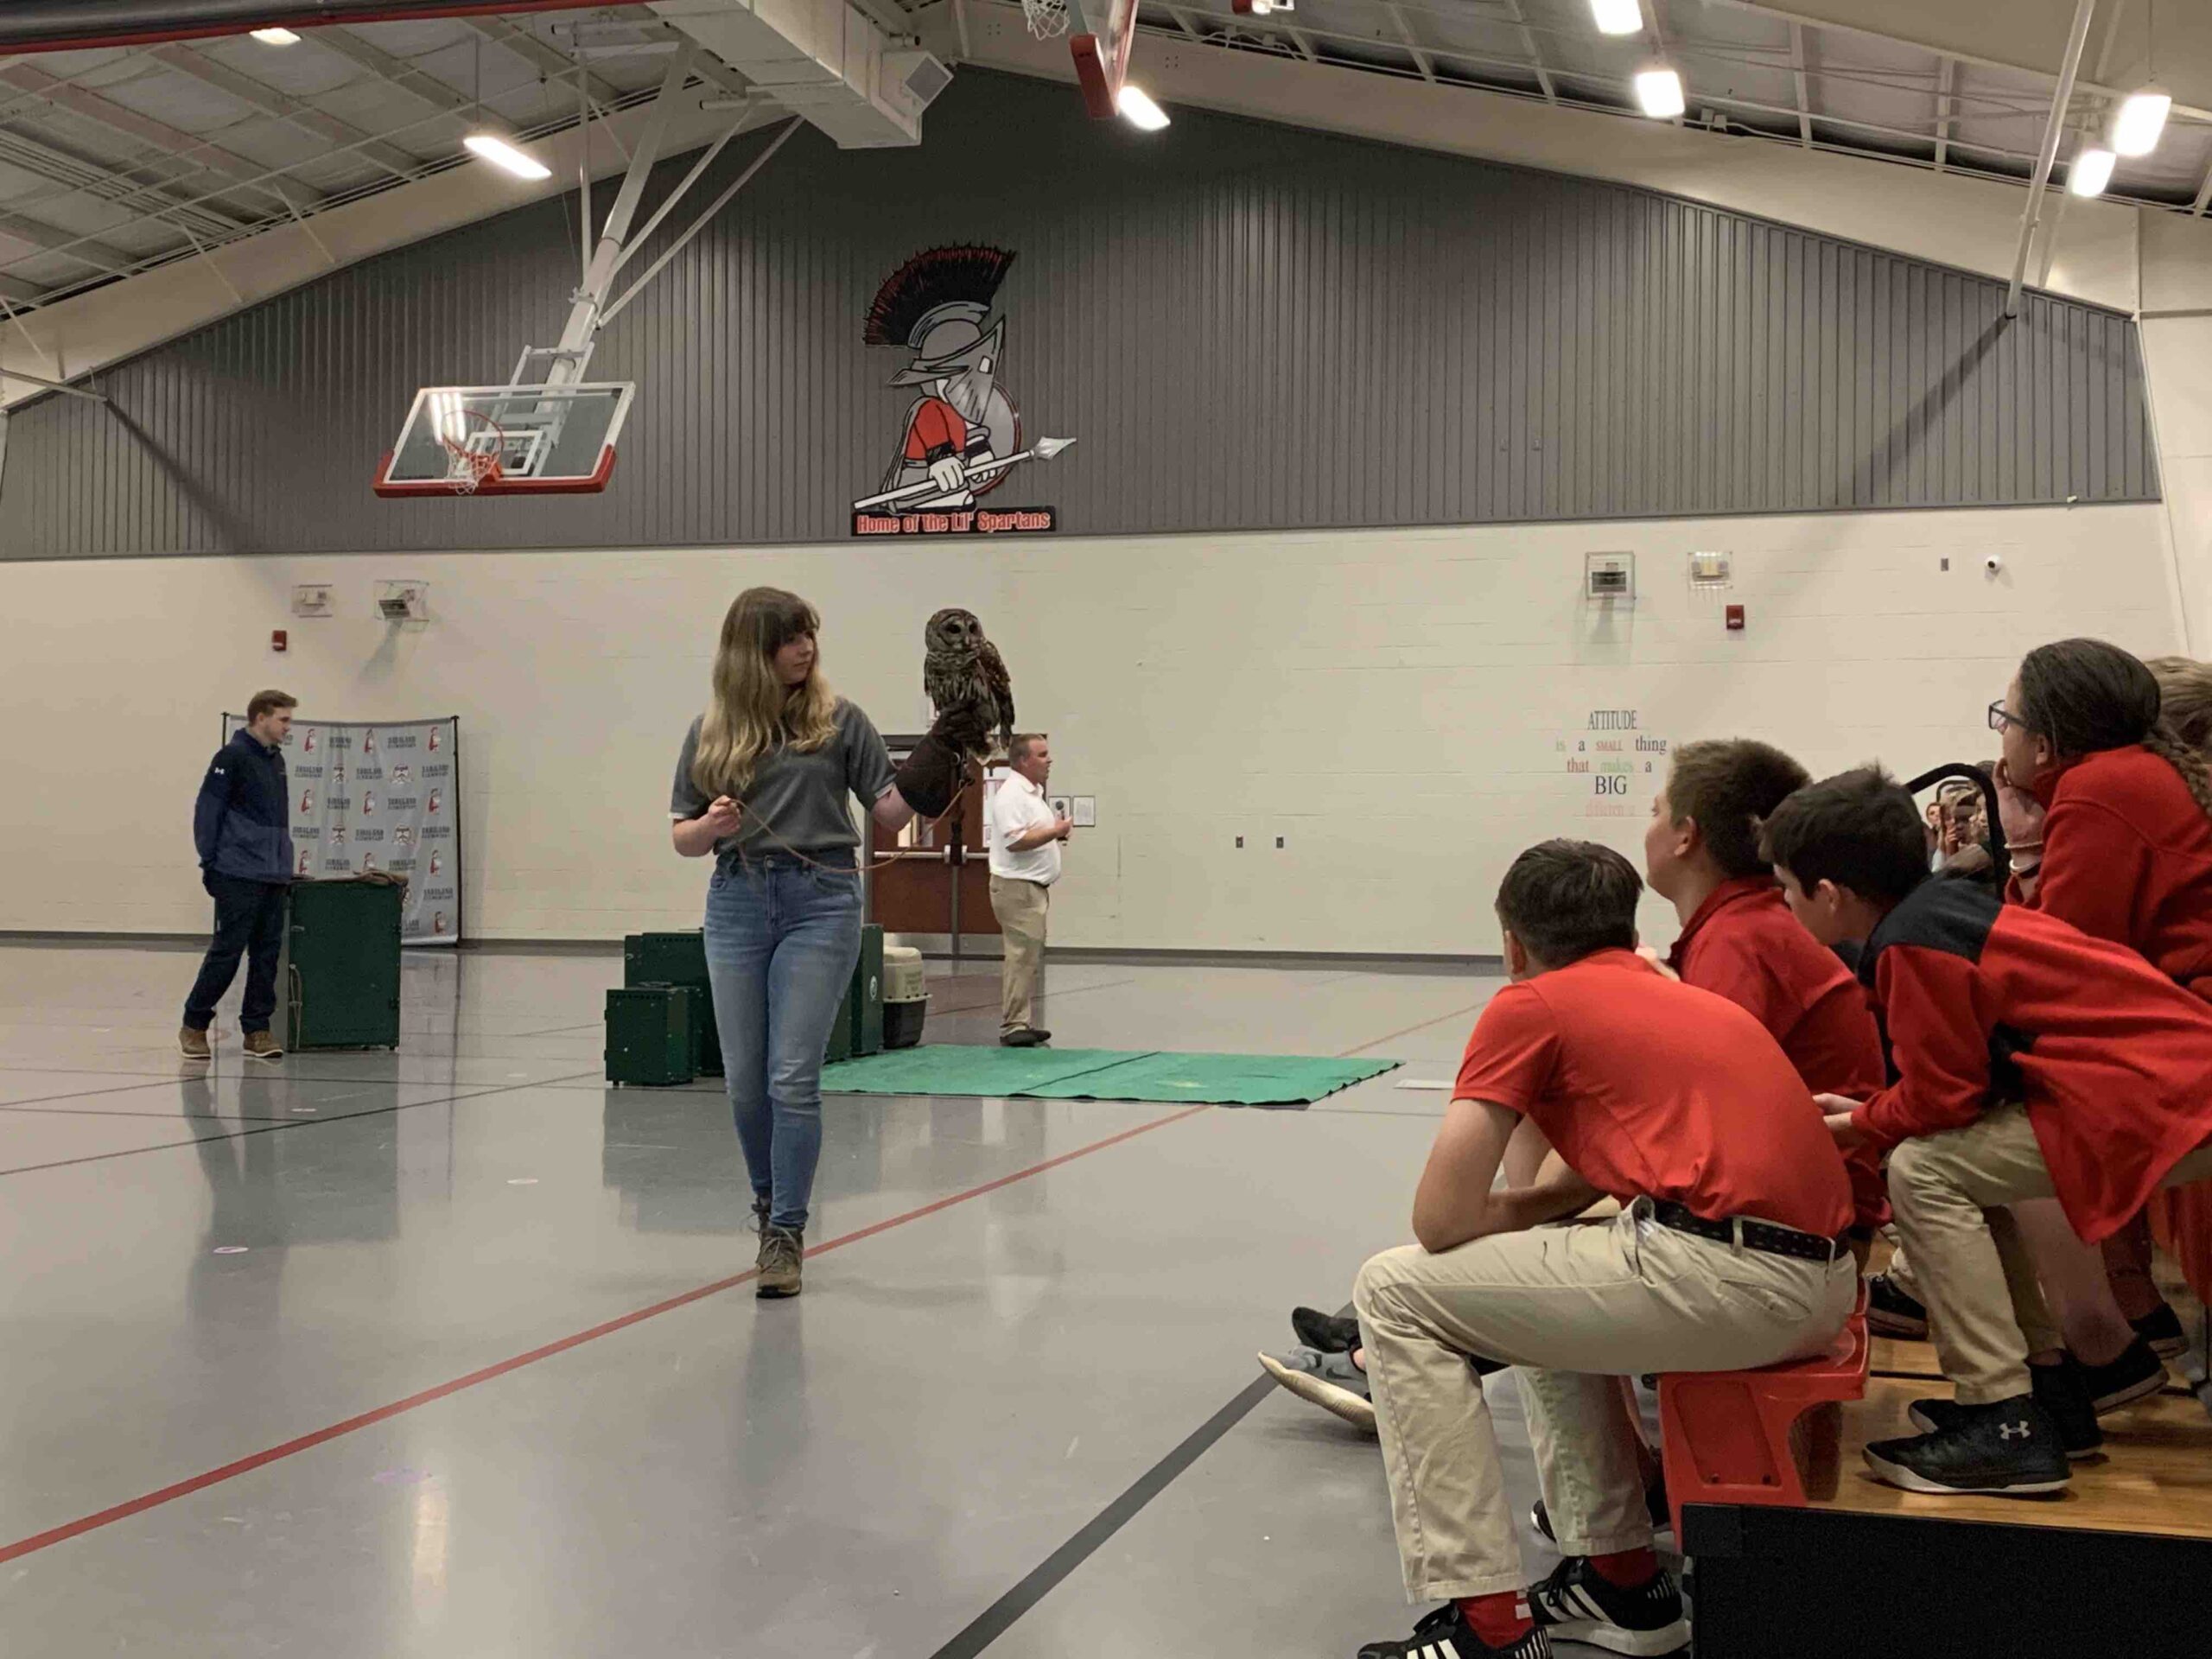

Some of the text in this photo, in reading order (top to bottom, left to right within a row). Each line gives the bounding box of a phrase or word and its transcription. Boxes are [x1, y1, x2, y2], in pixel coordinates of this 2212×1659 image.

[857, 511, 1051, 533] Home of the Lil' Spartans
[1587, 710, 1637, 730] ATTITUDE
[1555, 735, 1667, 755] is a SMALL thing
[1567, 757, 1652, 773] that makes a
[1594, 775, 1627, 795] BIG
